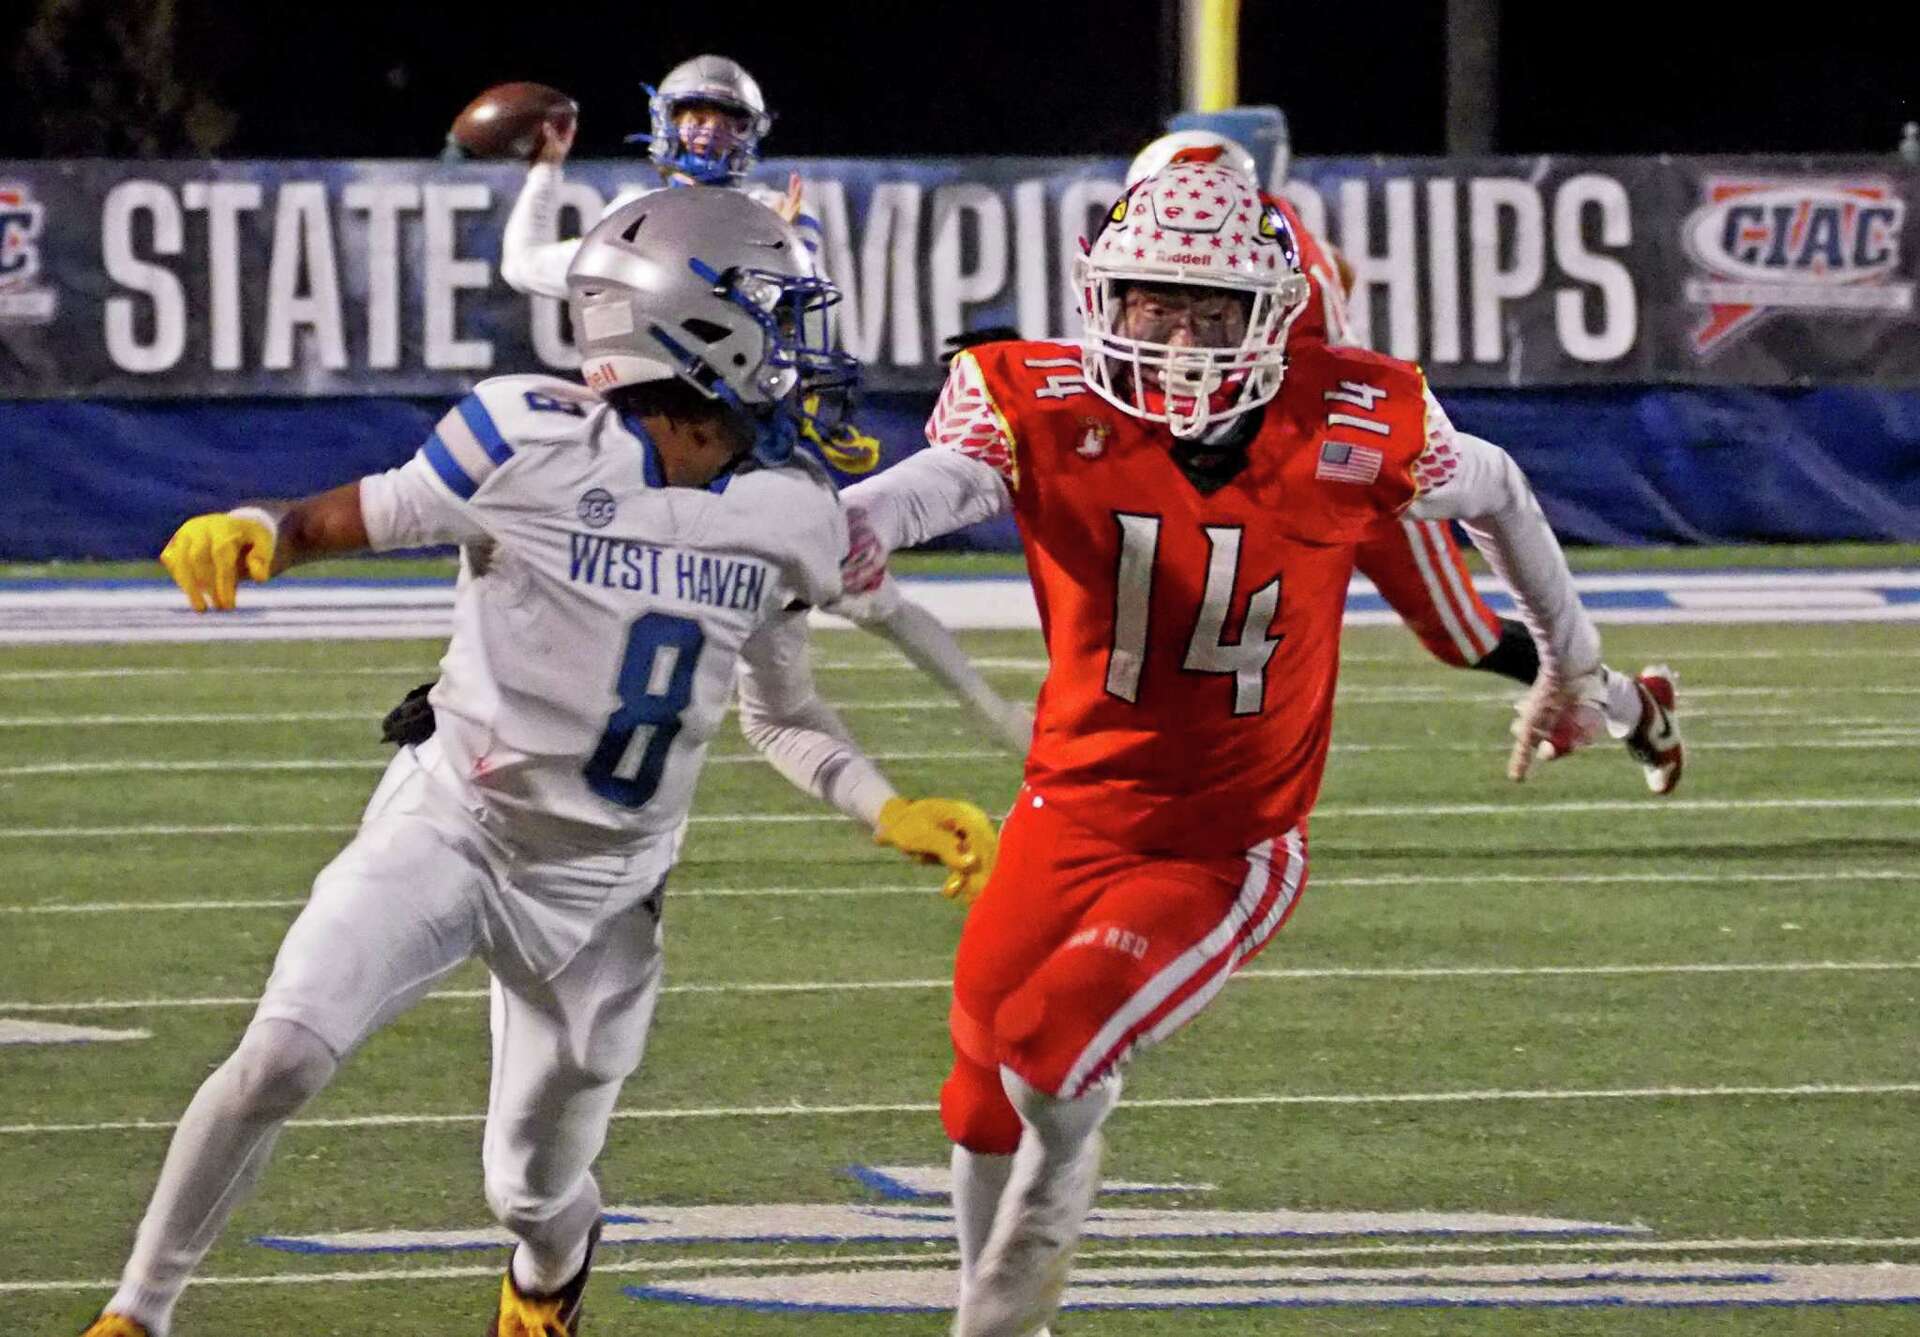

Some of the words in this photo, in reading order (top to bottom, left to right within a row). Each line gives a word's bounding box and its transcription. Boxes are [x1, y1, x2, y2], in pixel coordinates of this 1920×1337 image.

[103, 179, 496, 373] STATE
[531, 174, 1637, 370] CMPIHIPS
[1722, 204, 1896, 269] CIAC
[1324, 379, 1391, 436] 14
[569, 533, 661, 595] WEST
[675, 552, 768, 612] HAVEN
[1103, 510, 1285, 717] 14
[583, 611, 706, 809] 8
